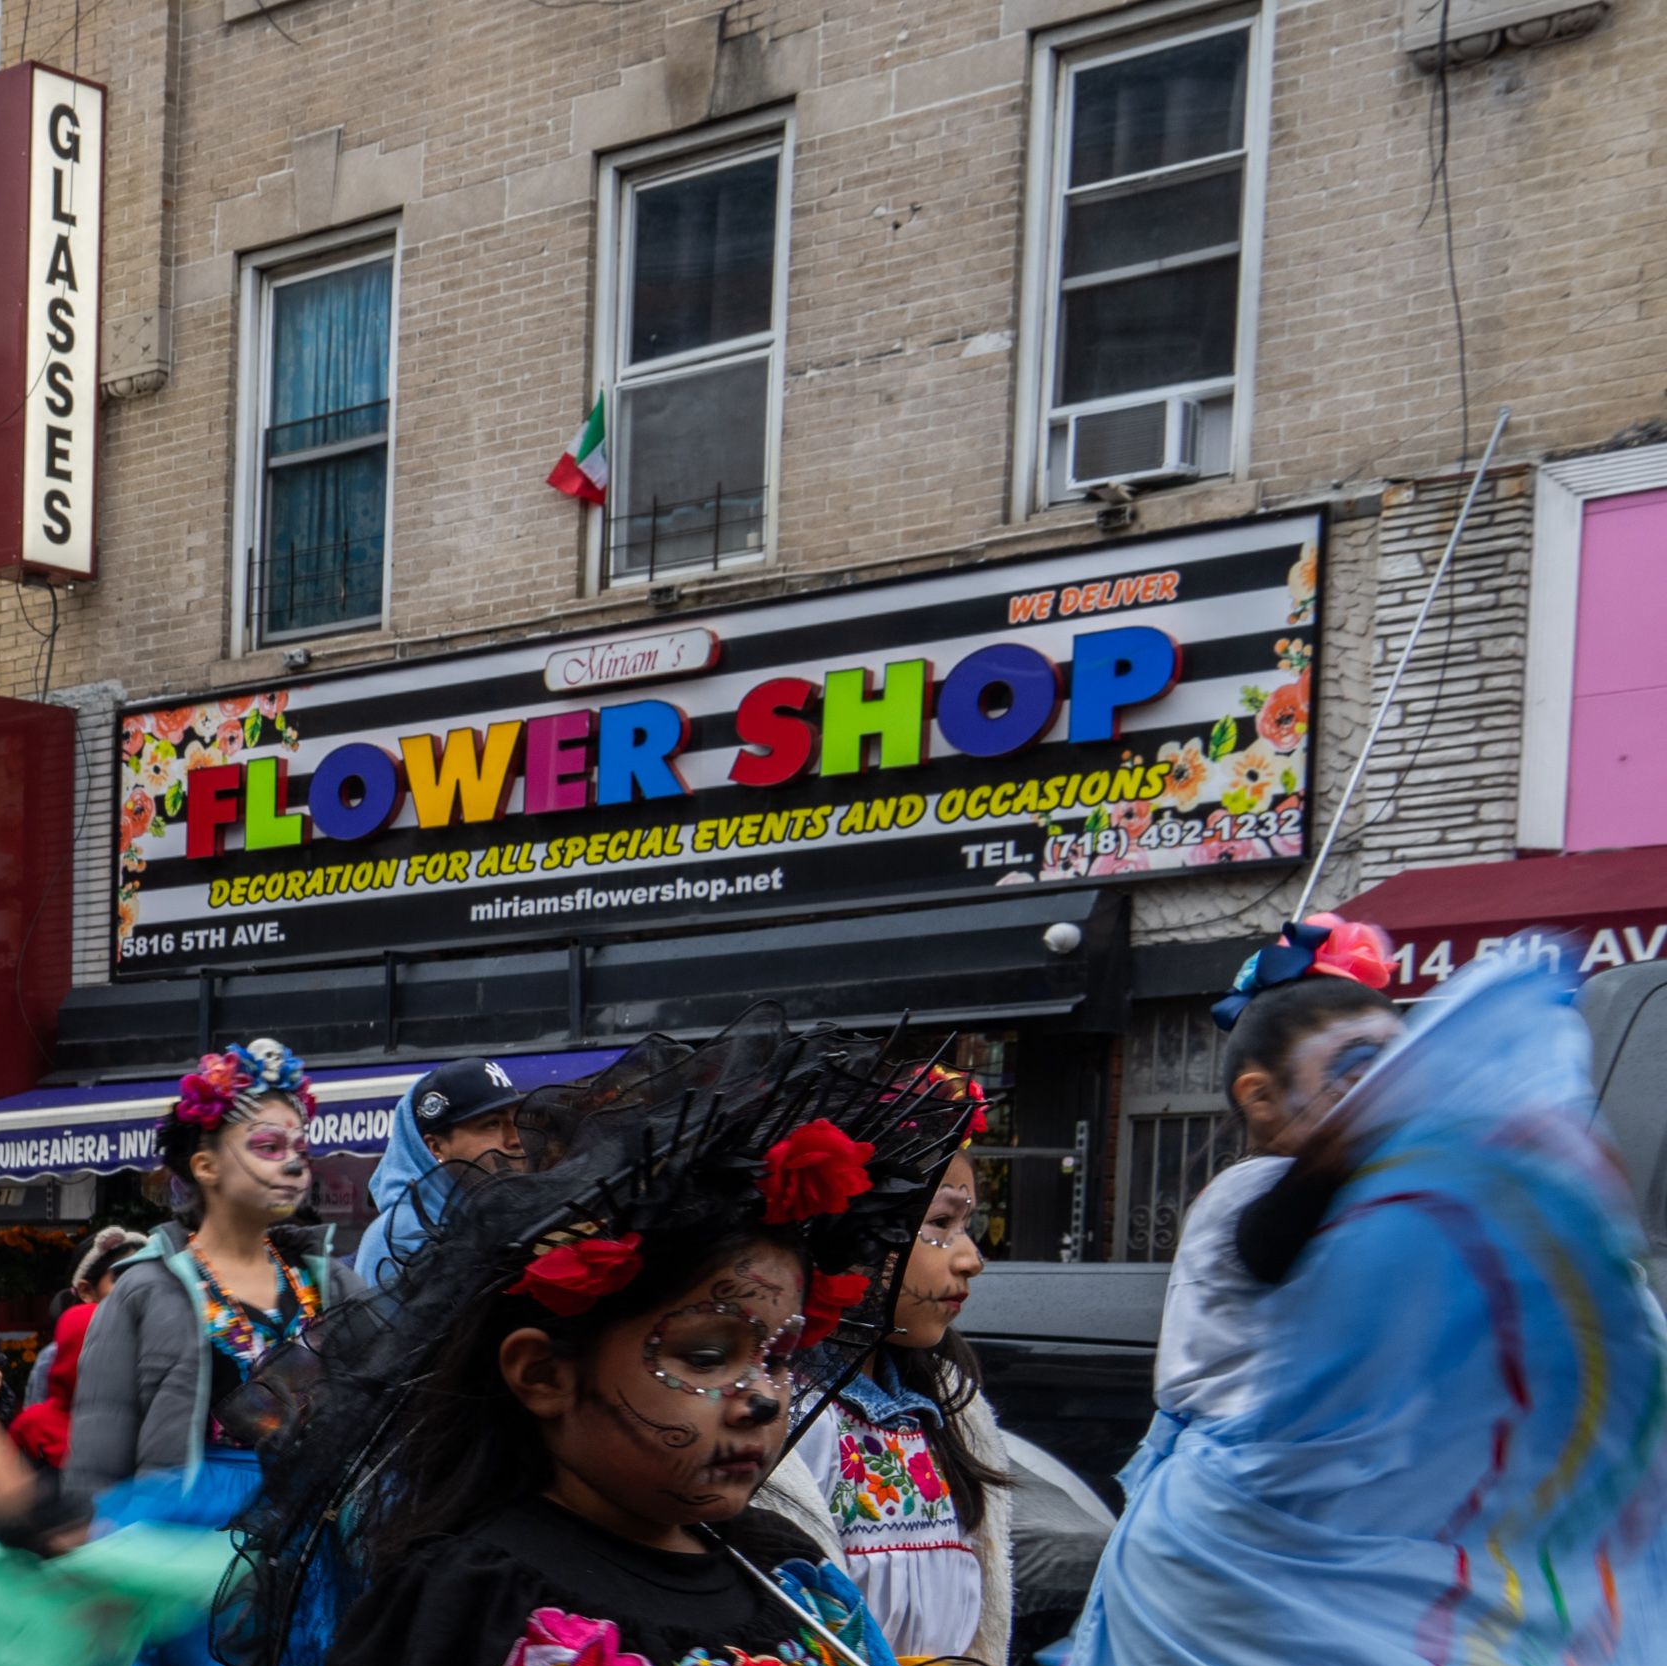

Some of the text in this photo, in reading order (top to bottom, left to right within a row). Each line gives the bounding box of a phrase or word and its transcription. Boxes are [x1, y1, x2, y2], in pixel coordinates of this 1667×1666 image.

[42, 103, 81, 545] GLASSES
[1008, 571, 1181, 625] WE DELIVER
[186, 626, 1178, 859] FLOWER SHOP
[208, 760, 1172, 908] DECORATION FOR ALL SPECIAL EVENTS AND OCCASIONS
[961, 807, 1301, 869] TEL. (718) 492-1232
[470, 867, 783, 922] miriamsflowershop.net
[122, 921, 286, 958] 5816 5TH AVE.
[1392, 940, 1455, 985] 14
